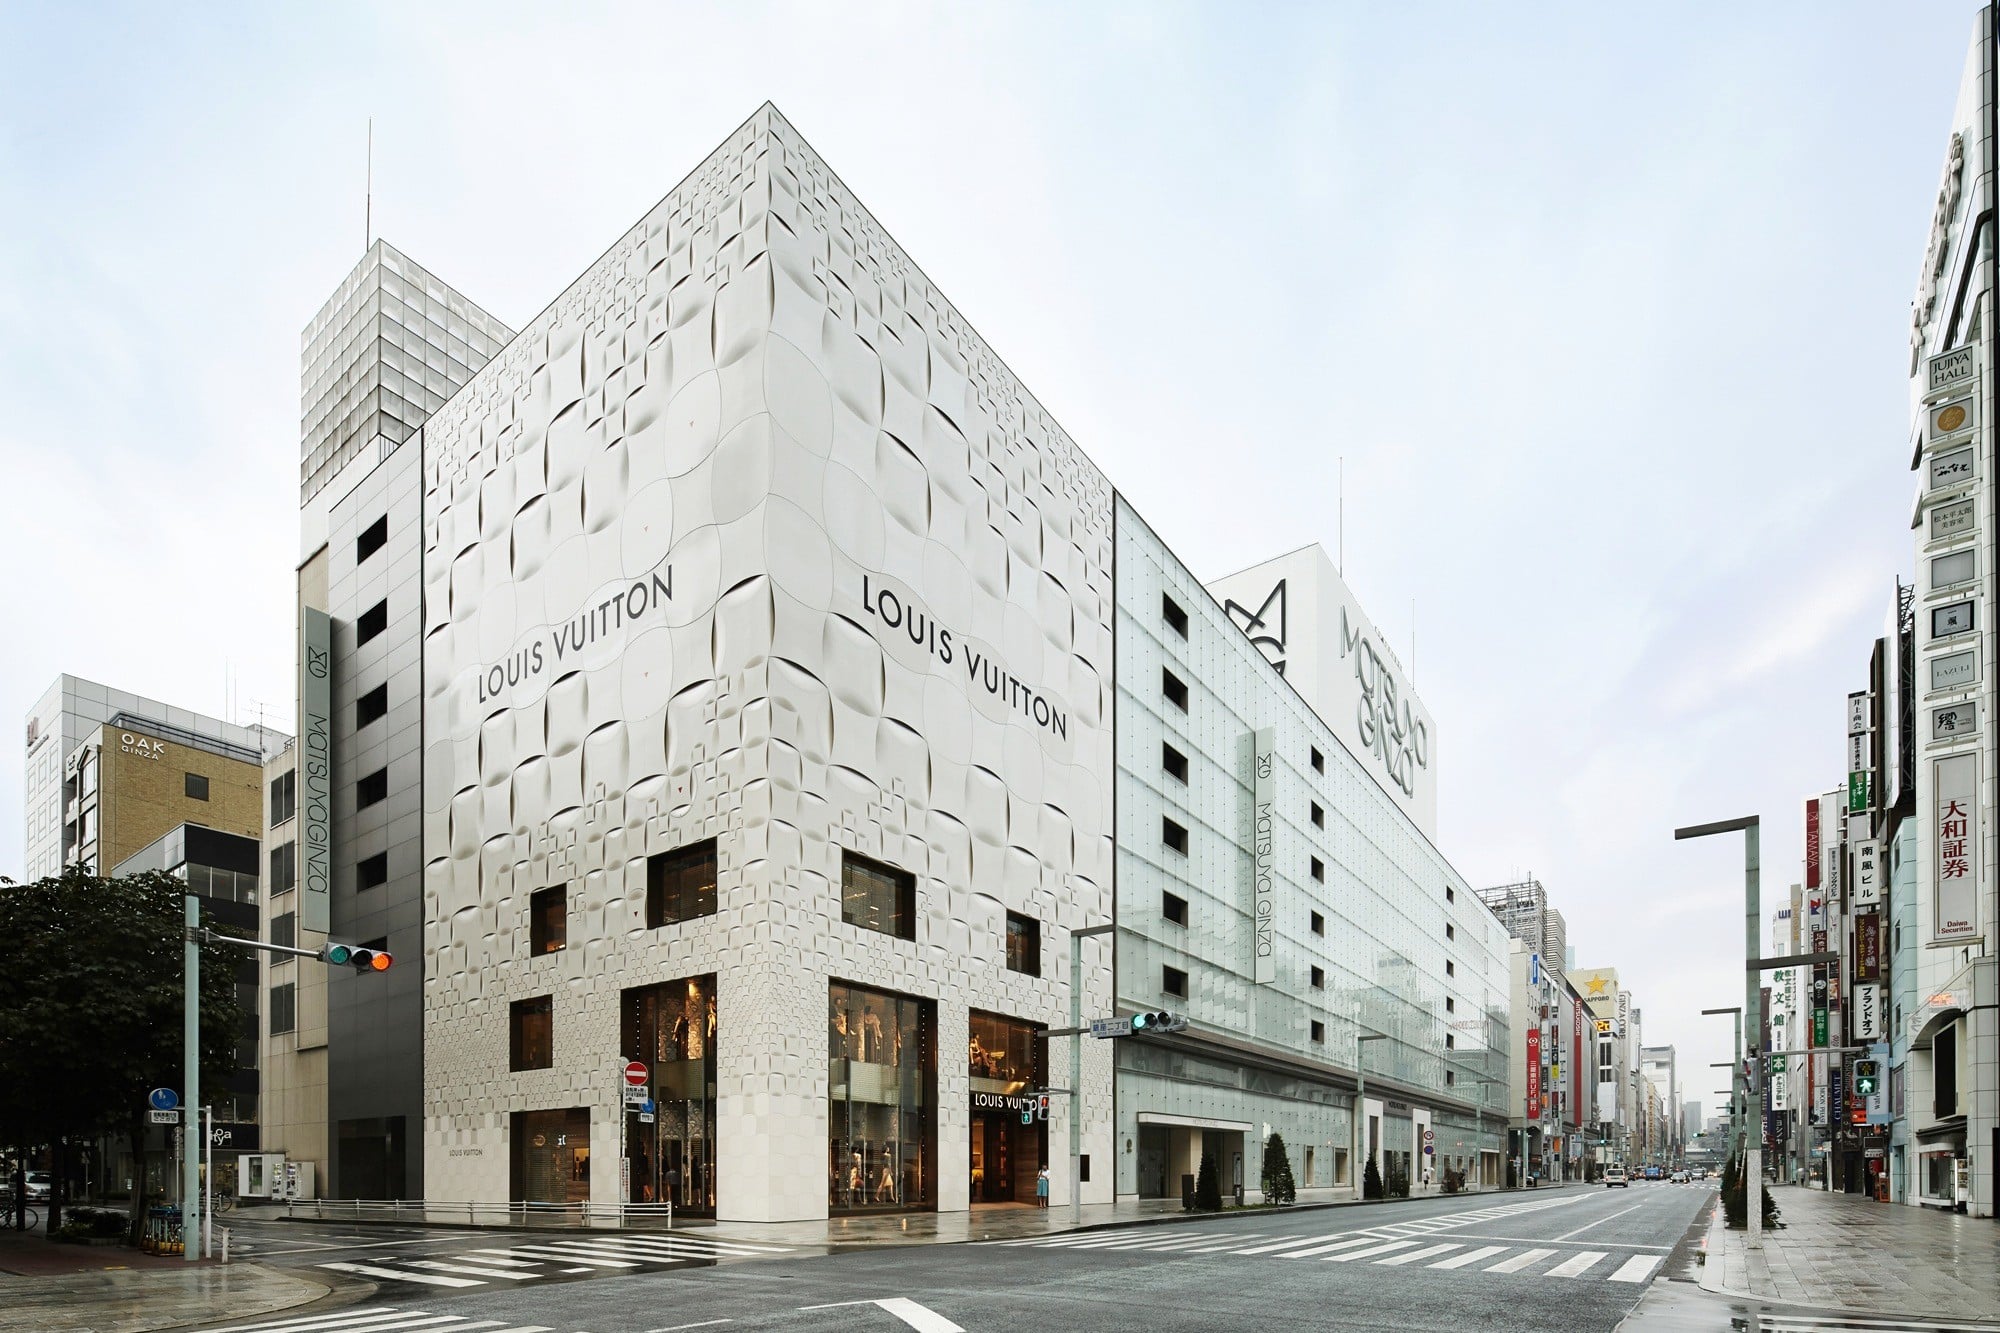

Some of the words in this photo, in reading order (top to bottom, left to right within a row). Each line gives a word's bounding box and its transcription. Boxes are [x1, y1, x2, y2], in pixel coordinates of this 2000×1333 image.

[1934, 353, 1969, 375] JUJIYA
[1935, 366, 1968, 384] HALL
[479, 640, 542, 704] LOUIS
[553, 564, 674, 661] VUITTON
[863, 574, 953, 666] LOUIS
[964, 644, 1067, 743] VUITTON
[121, 733, 165, 754] OAK
[121, 745, 160, 761] GINZA
[1940, 800, 1969, 880] 大和証券
[1861, 846, 1874, 898] 南風ビル
[1941, 925, 1973, 935] Securities
[1947, 920, 1968, 928] Daiwa
[1773, 969, 1785, 1026] 教文館
[1862, 986, 1873, 1035] ブランドオフ
[1773, 1057, 1784, 1070] 本
[975, 1093, 1003, 1108] LOUIS
[1006, 1096, 1037, 1111] VUIO
[1833, 1075, 1841, 1120] CHAUMET
[1775, 1119, 1783, 1145] ヨシノヤ
